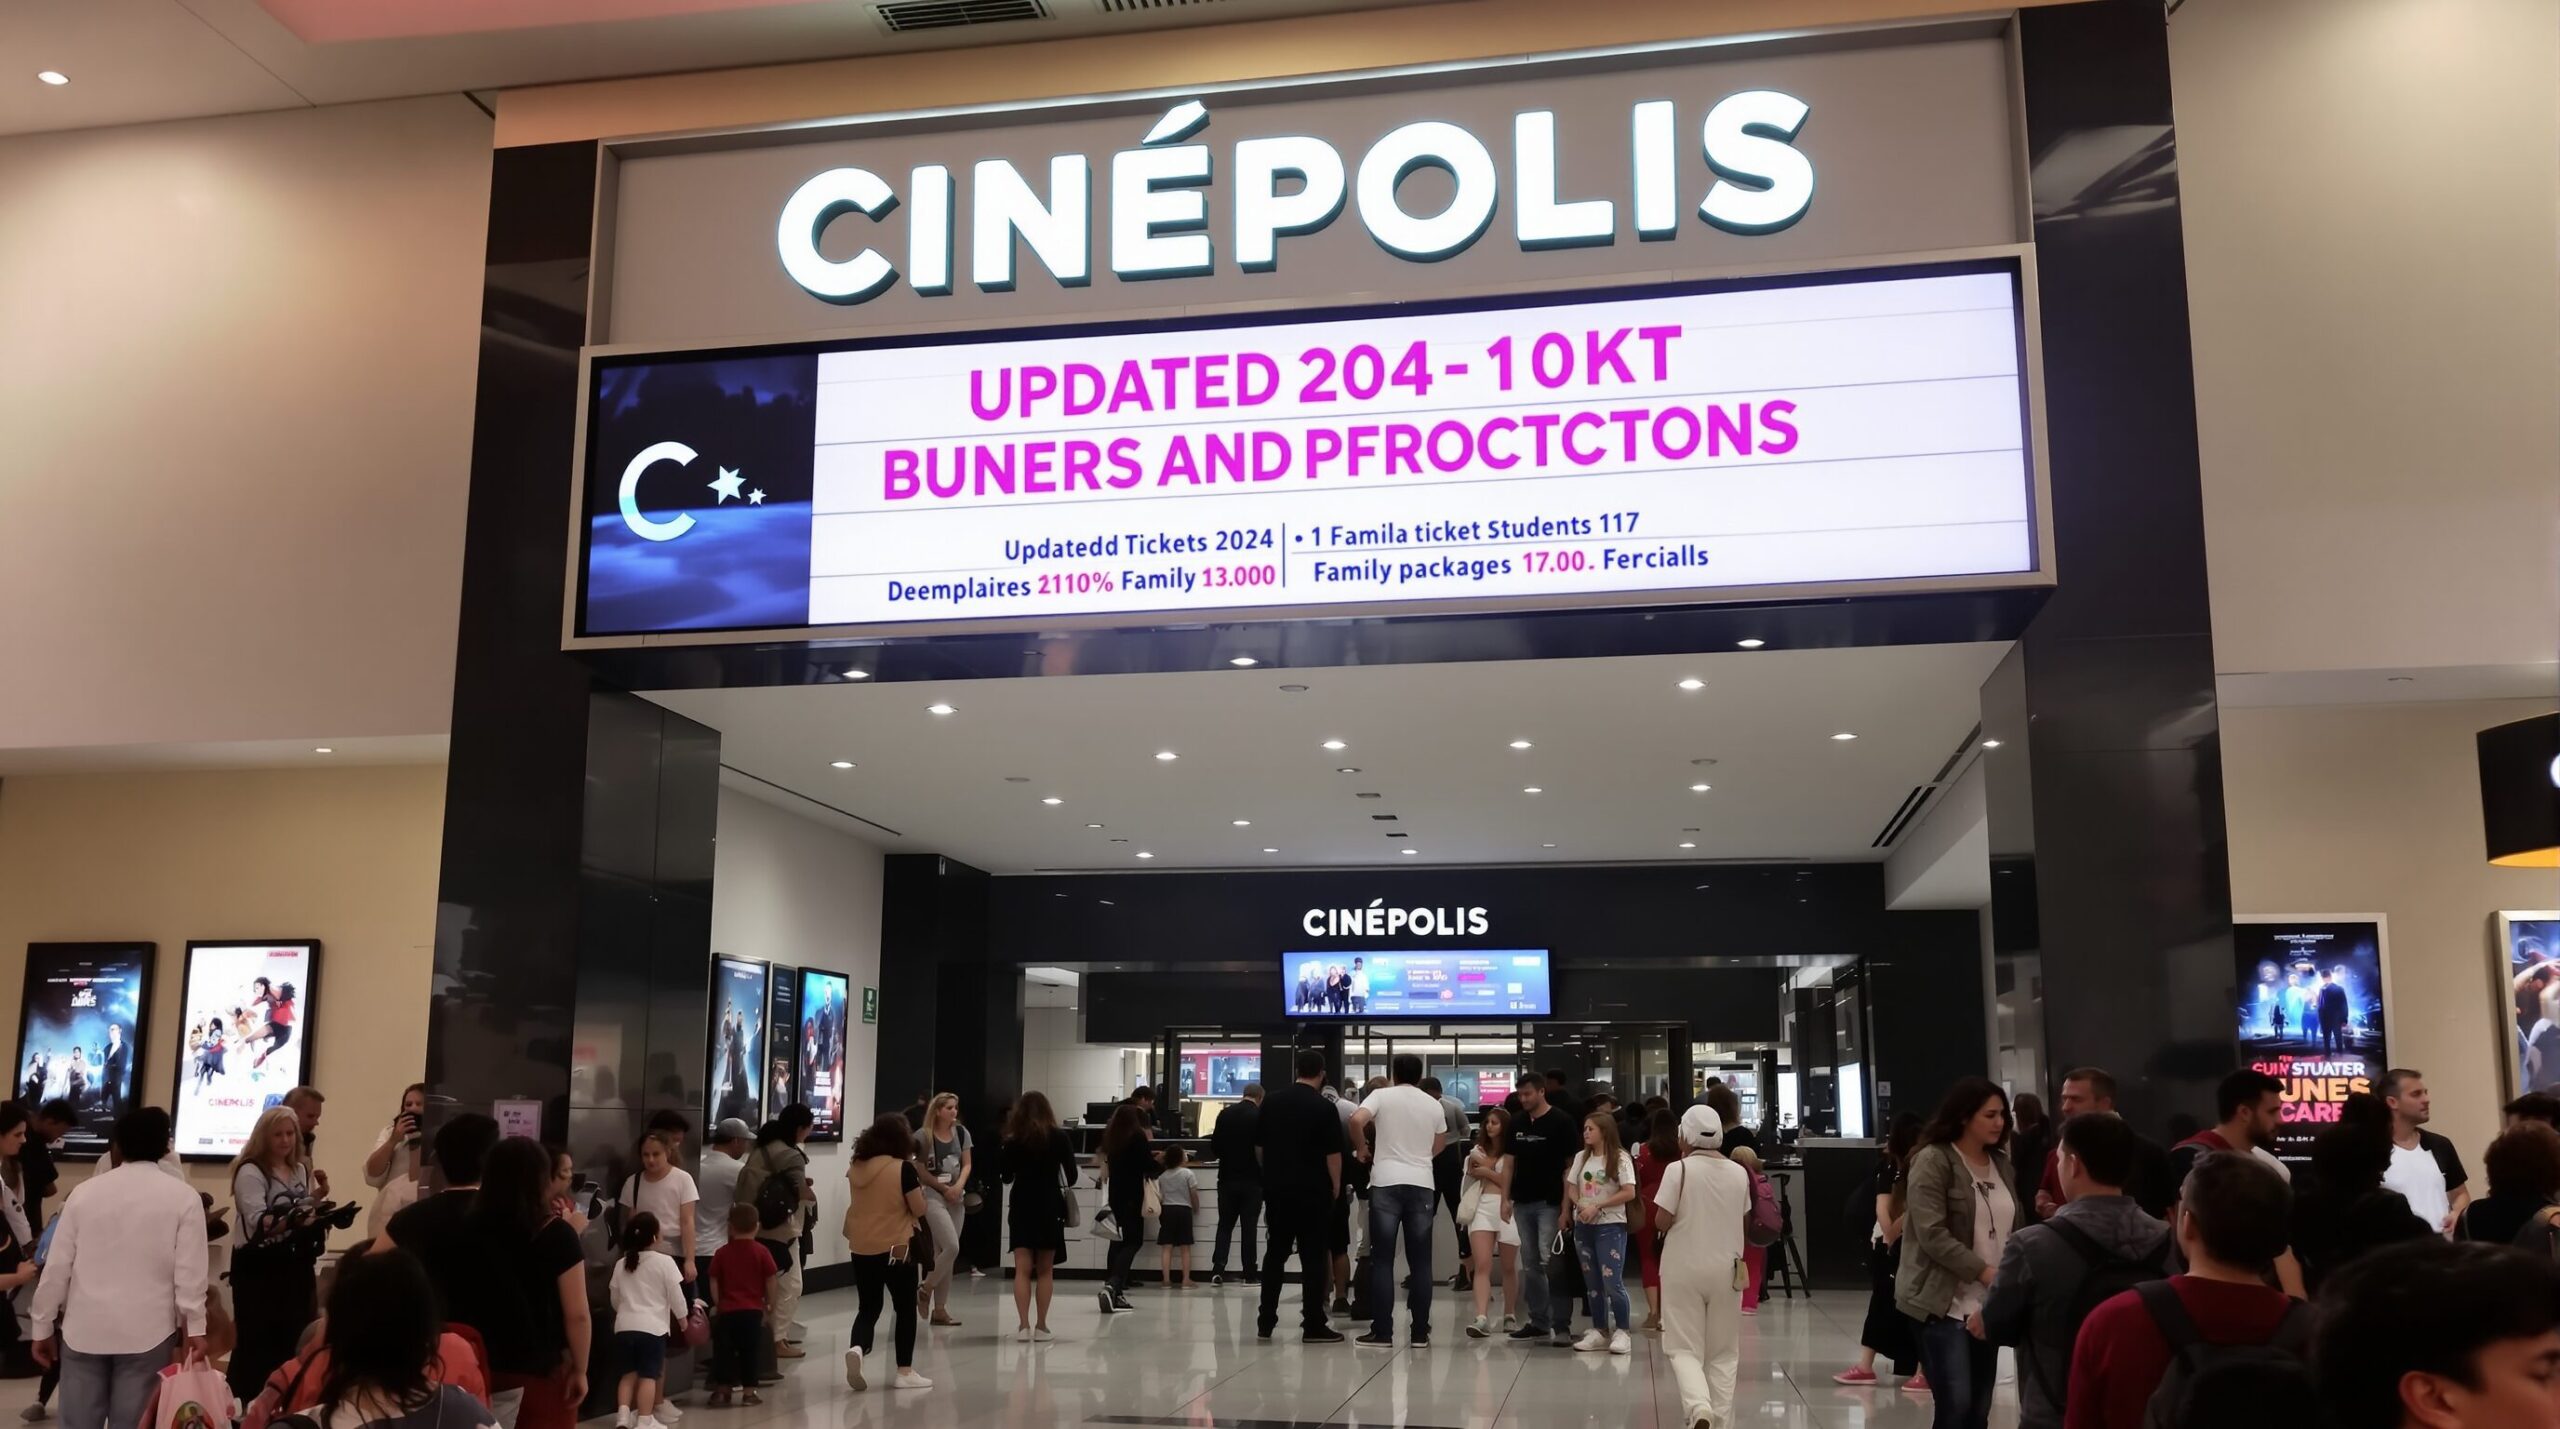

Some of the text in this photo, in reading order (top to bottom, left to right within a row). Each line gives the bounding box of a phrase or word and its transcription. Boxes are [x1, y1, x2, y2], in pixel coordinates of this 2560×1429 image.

[777, 91, 1815, 305] CINÉPOLIS
[971, 353, 1280, 421] UPDATED
[885, 400, 1799, 500] BUNERS AND PFROCTCTONS
[1005, 529, 1274, 562] Updatedd Tickets 2024
[1311, 512, 1640, 545] 1 Famila ticket Students 117
[1038, 572, 1114, 594] 2110%
[1122, 567, 1196, 592] Family
[1203, 565, 1277, 587] 13.000
[1314, 560, 1392, 583] Family
[1399, 555, 1512, 584] packages
[1602, 545, 1710, 570] Fercialls
[1303, 897, 1489, 936] CINÉPOLIS
